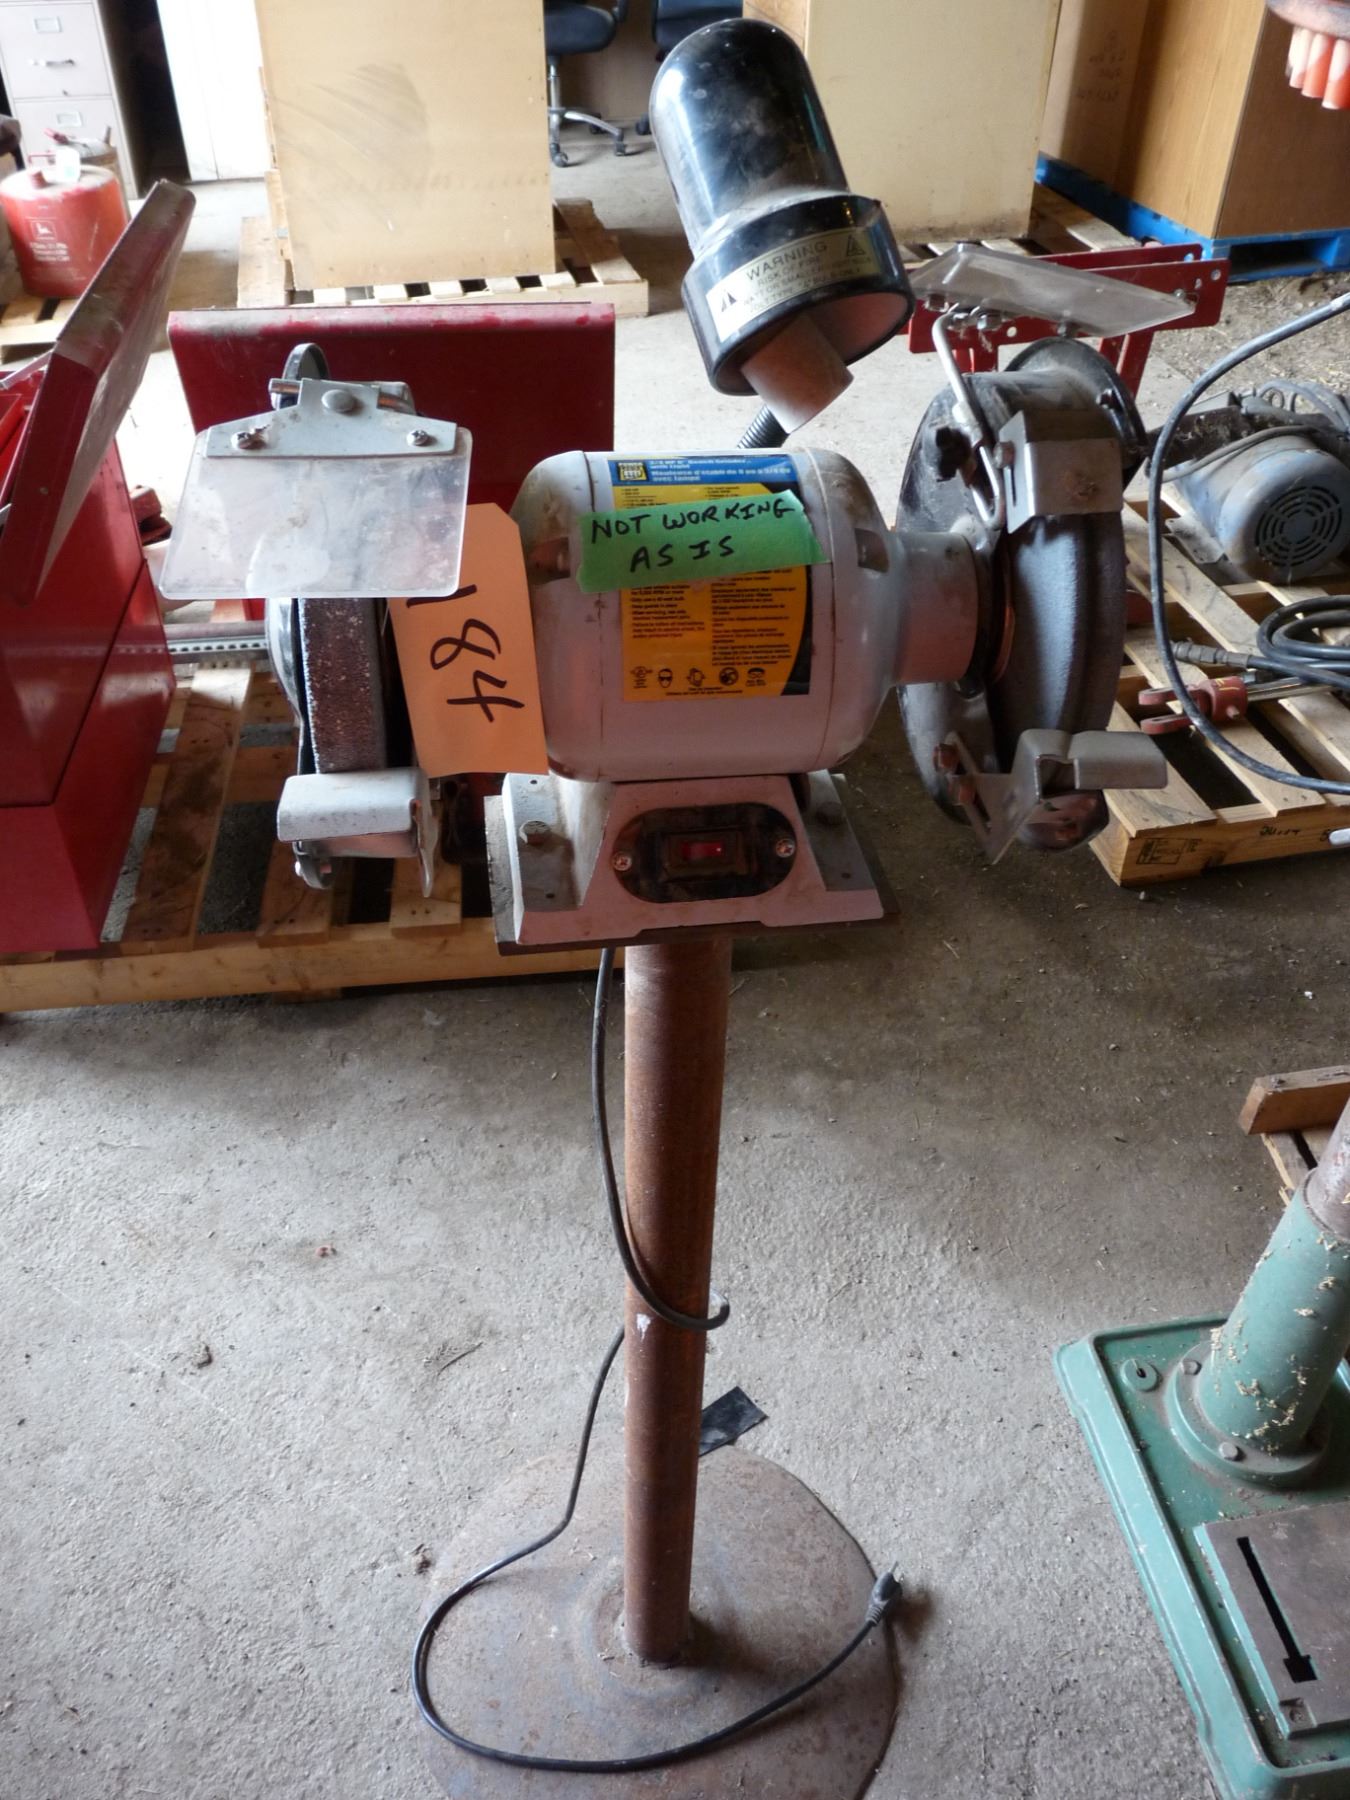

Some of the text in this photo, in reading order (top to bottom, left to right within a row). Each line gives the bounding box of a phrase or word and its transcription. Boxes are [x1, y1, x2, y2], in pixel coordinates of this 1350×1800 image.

[747, 241, 827, 280] WARNING
[591, 498, 795, 544] NOT WORKING
[629, 535, 735, 573] AS IS
